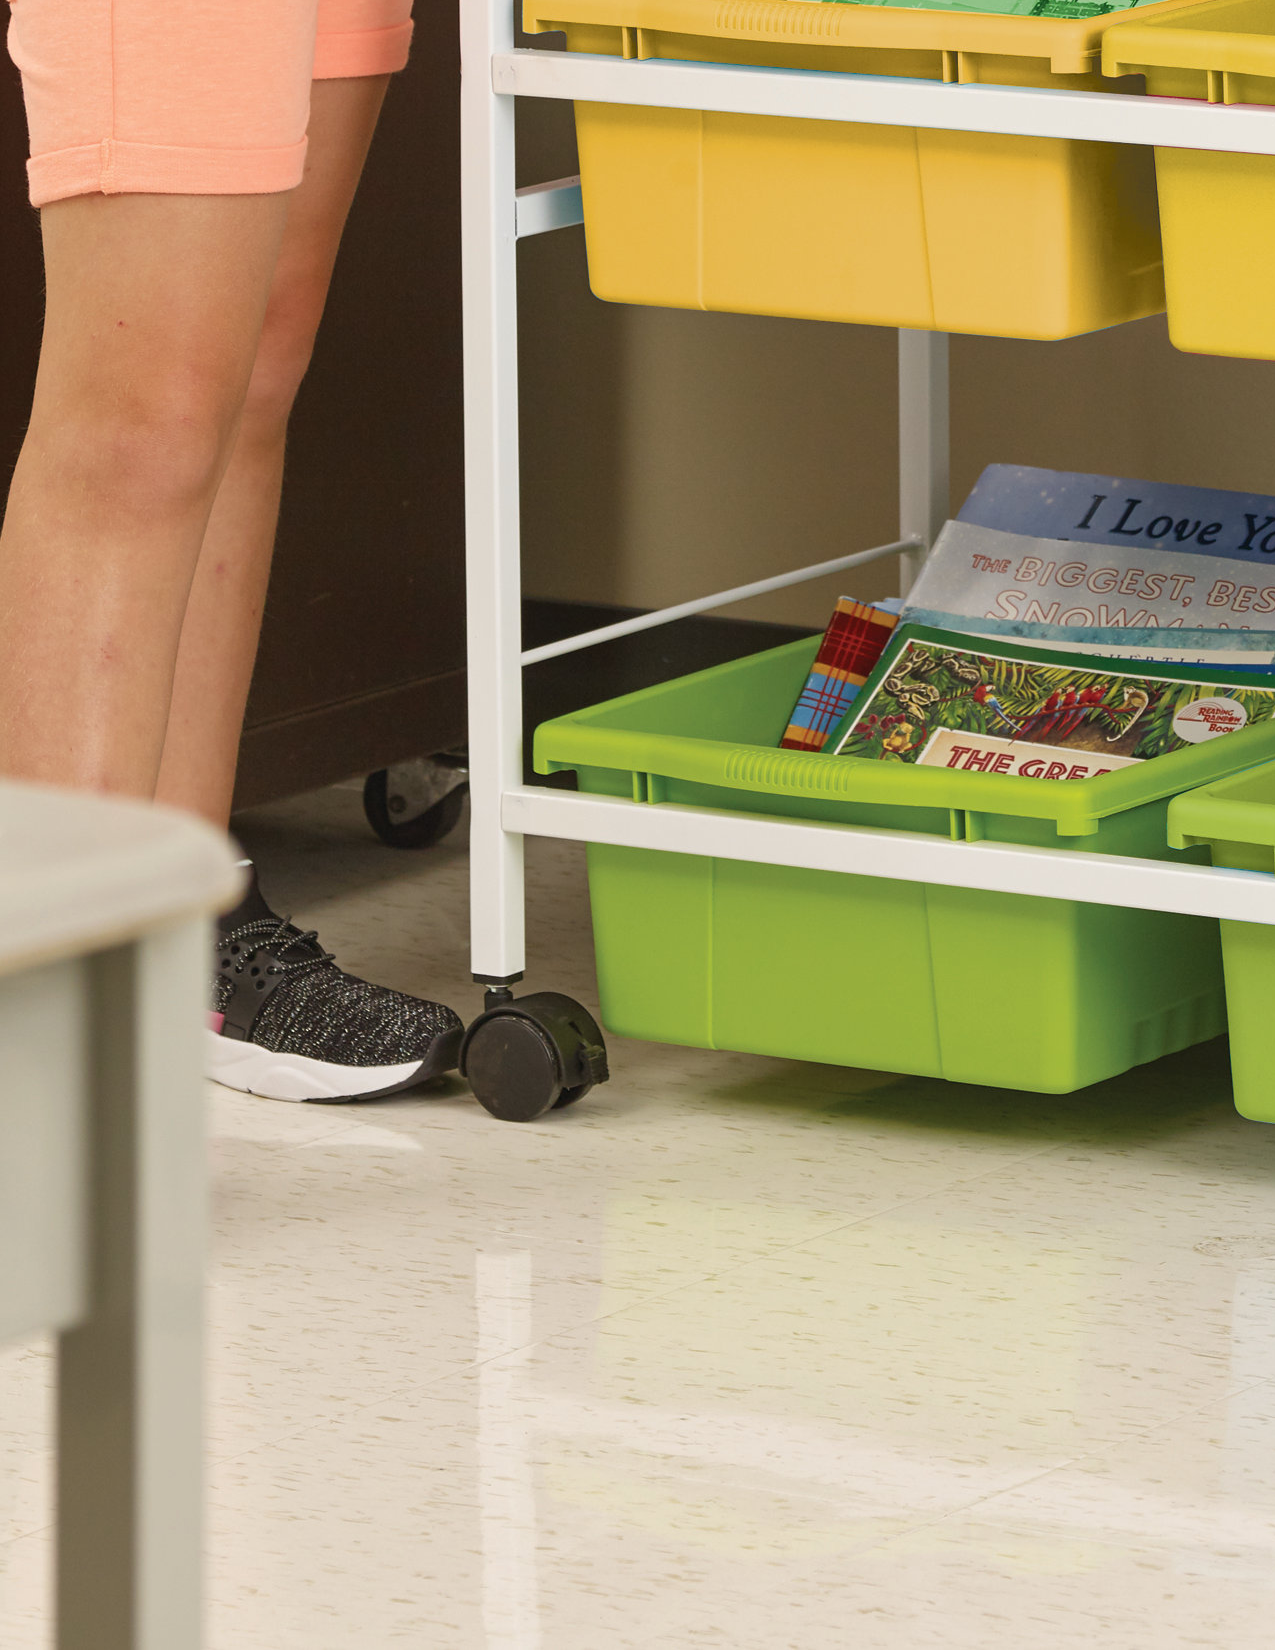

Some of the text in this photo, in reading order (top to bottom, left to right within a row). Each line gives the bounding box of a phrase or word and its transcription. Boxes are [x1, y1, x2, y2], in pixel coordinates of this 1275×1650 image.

[1074, 495, 1107, 529] I
[1109, 498, 1224, 546] Love
[971, 554, 1012, 574] THE
[1015, 556, 1196, 607] BIGGEST,
[1198, 707, 1234, 716] READING
[1203, 715, 1242, 723] RAINBOW
[947, 746, 1111, 781] THE GRE
